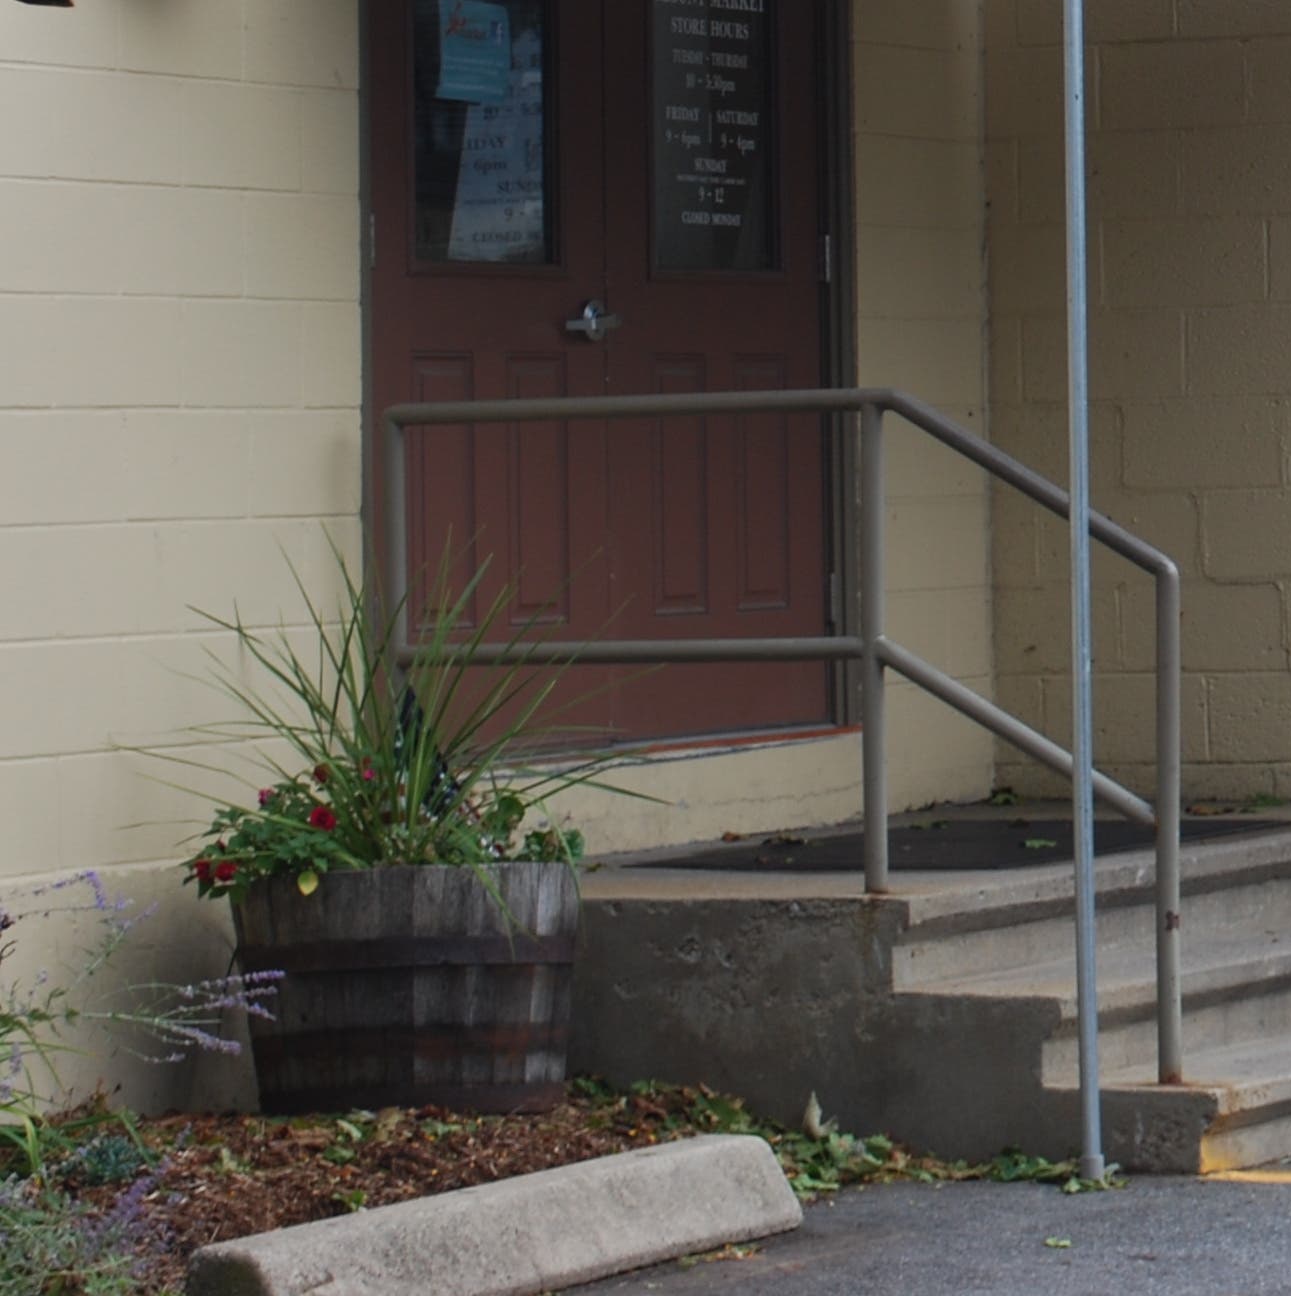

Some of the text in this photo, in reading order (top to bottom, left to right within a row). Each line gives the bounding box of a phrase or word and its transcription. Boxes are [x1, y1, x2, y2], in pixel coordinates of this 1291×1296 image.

[671, 16, 750, 40] STORE HOURS
[665, 105, 700, 122] FRIDAY
[694, 157, 728, 174] SUNDAY
[681, 210, 711, 226] CLOSED
